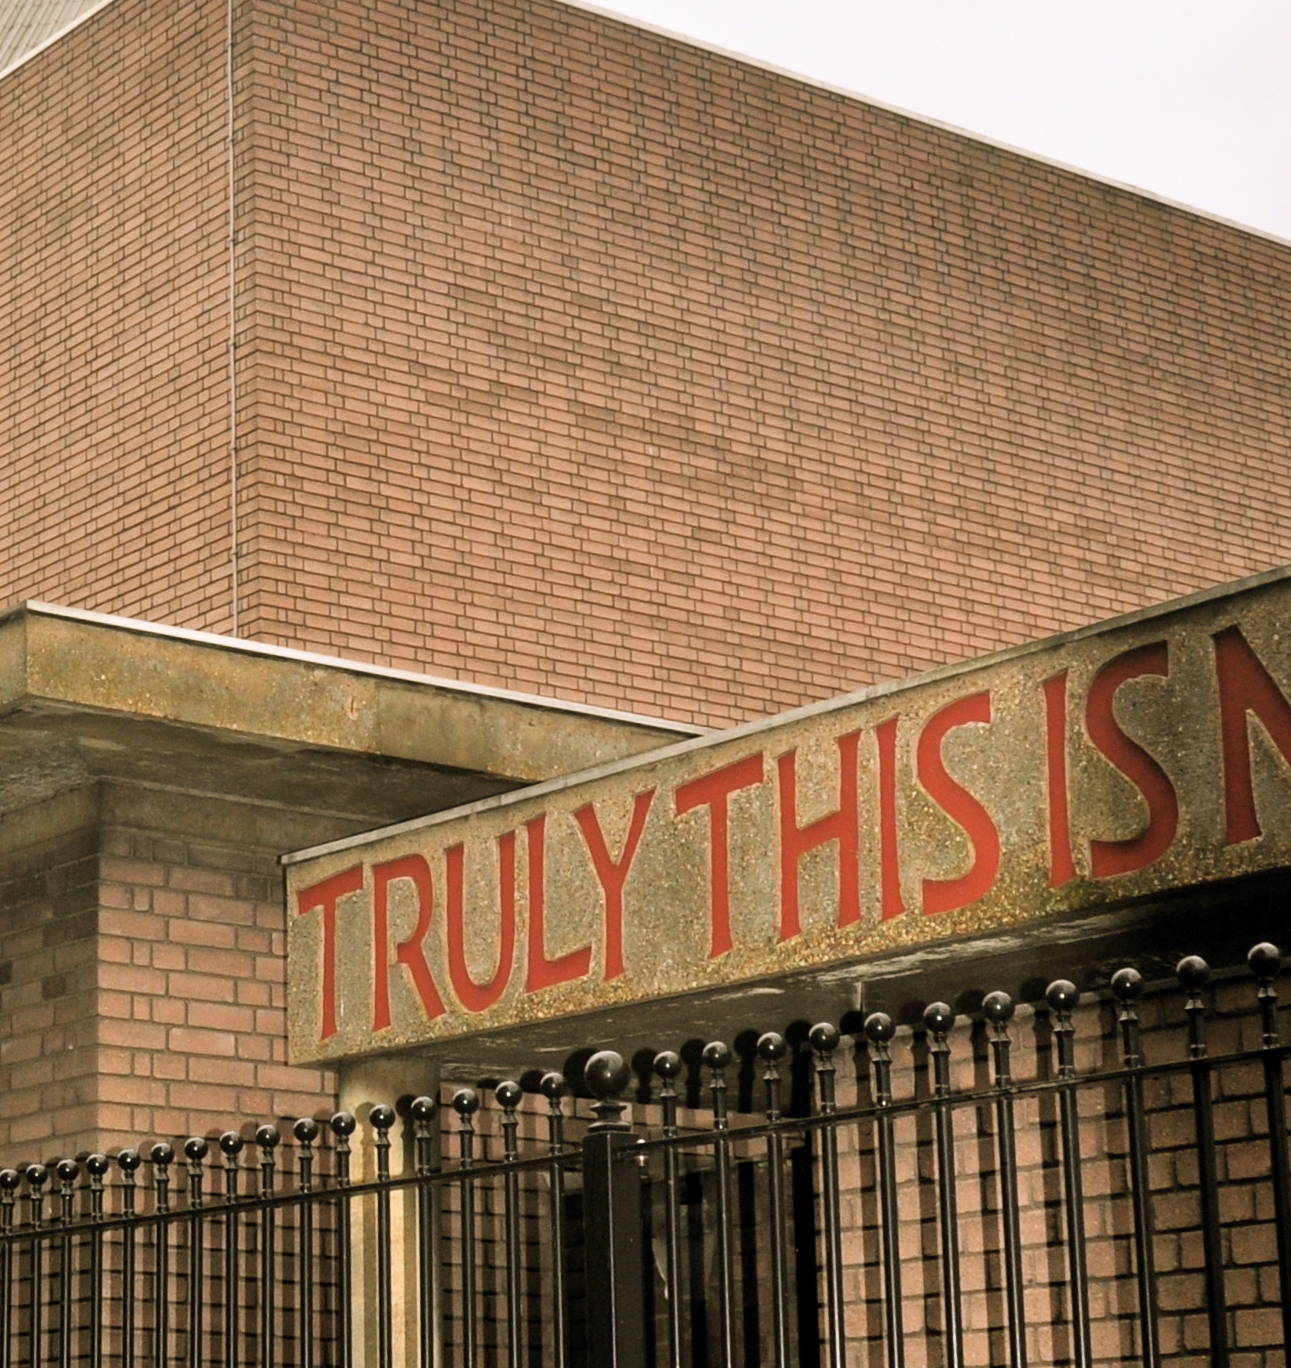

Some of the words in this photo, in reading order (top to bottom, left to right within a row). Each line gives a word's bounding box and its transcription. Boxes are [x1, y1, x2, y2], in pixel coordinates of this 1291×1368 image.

[297, 788, 658, 1041] TRULY
[674, 690, 1000, 960] THIS
[1042, 639, 1179, 889] IS
